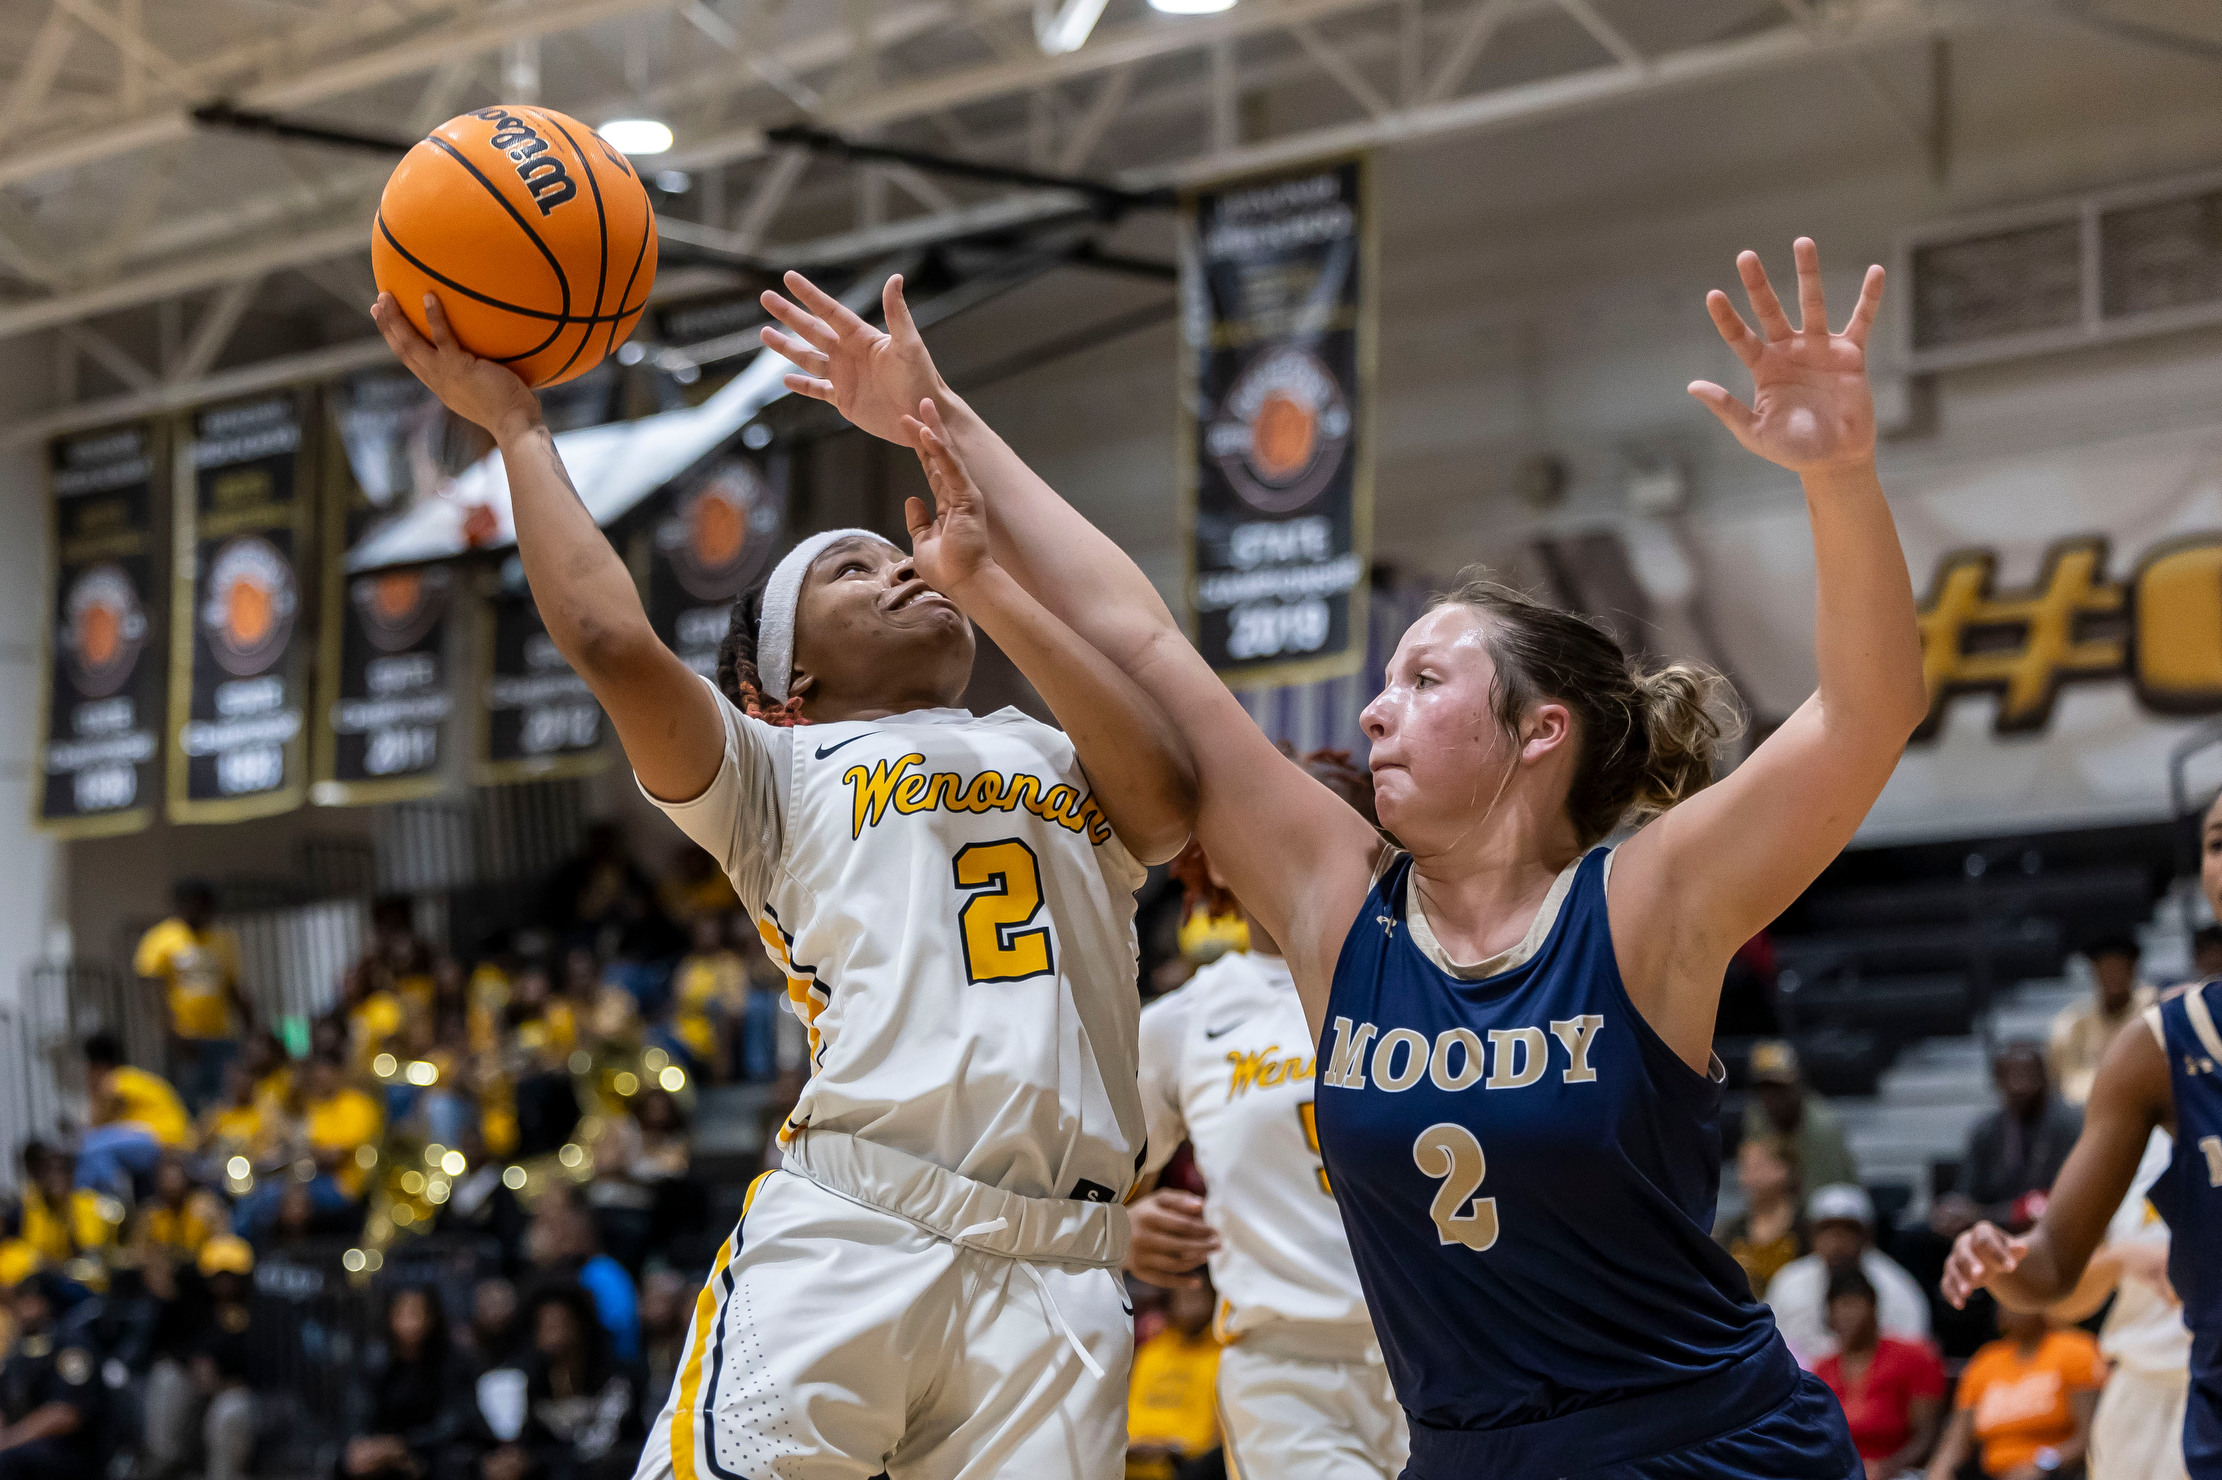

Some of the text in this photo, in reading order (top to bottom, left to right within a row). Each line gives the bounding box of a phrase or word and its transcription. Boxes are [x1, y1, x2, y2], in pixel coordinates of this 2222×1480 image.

[952, 836, 1055, 986] 2
[1323, 1014, 1604, 1093] MOODY
[1412, 1122, 1500, 1252] 2
